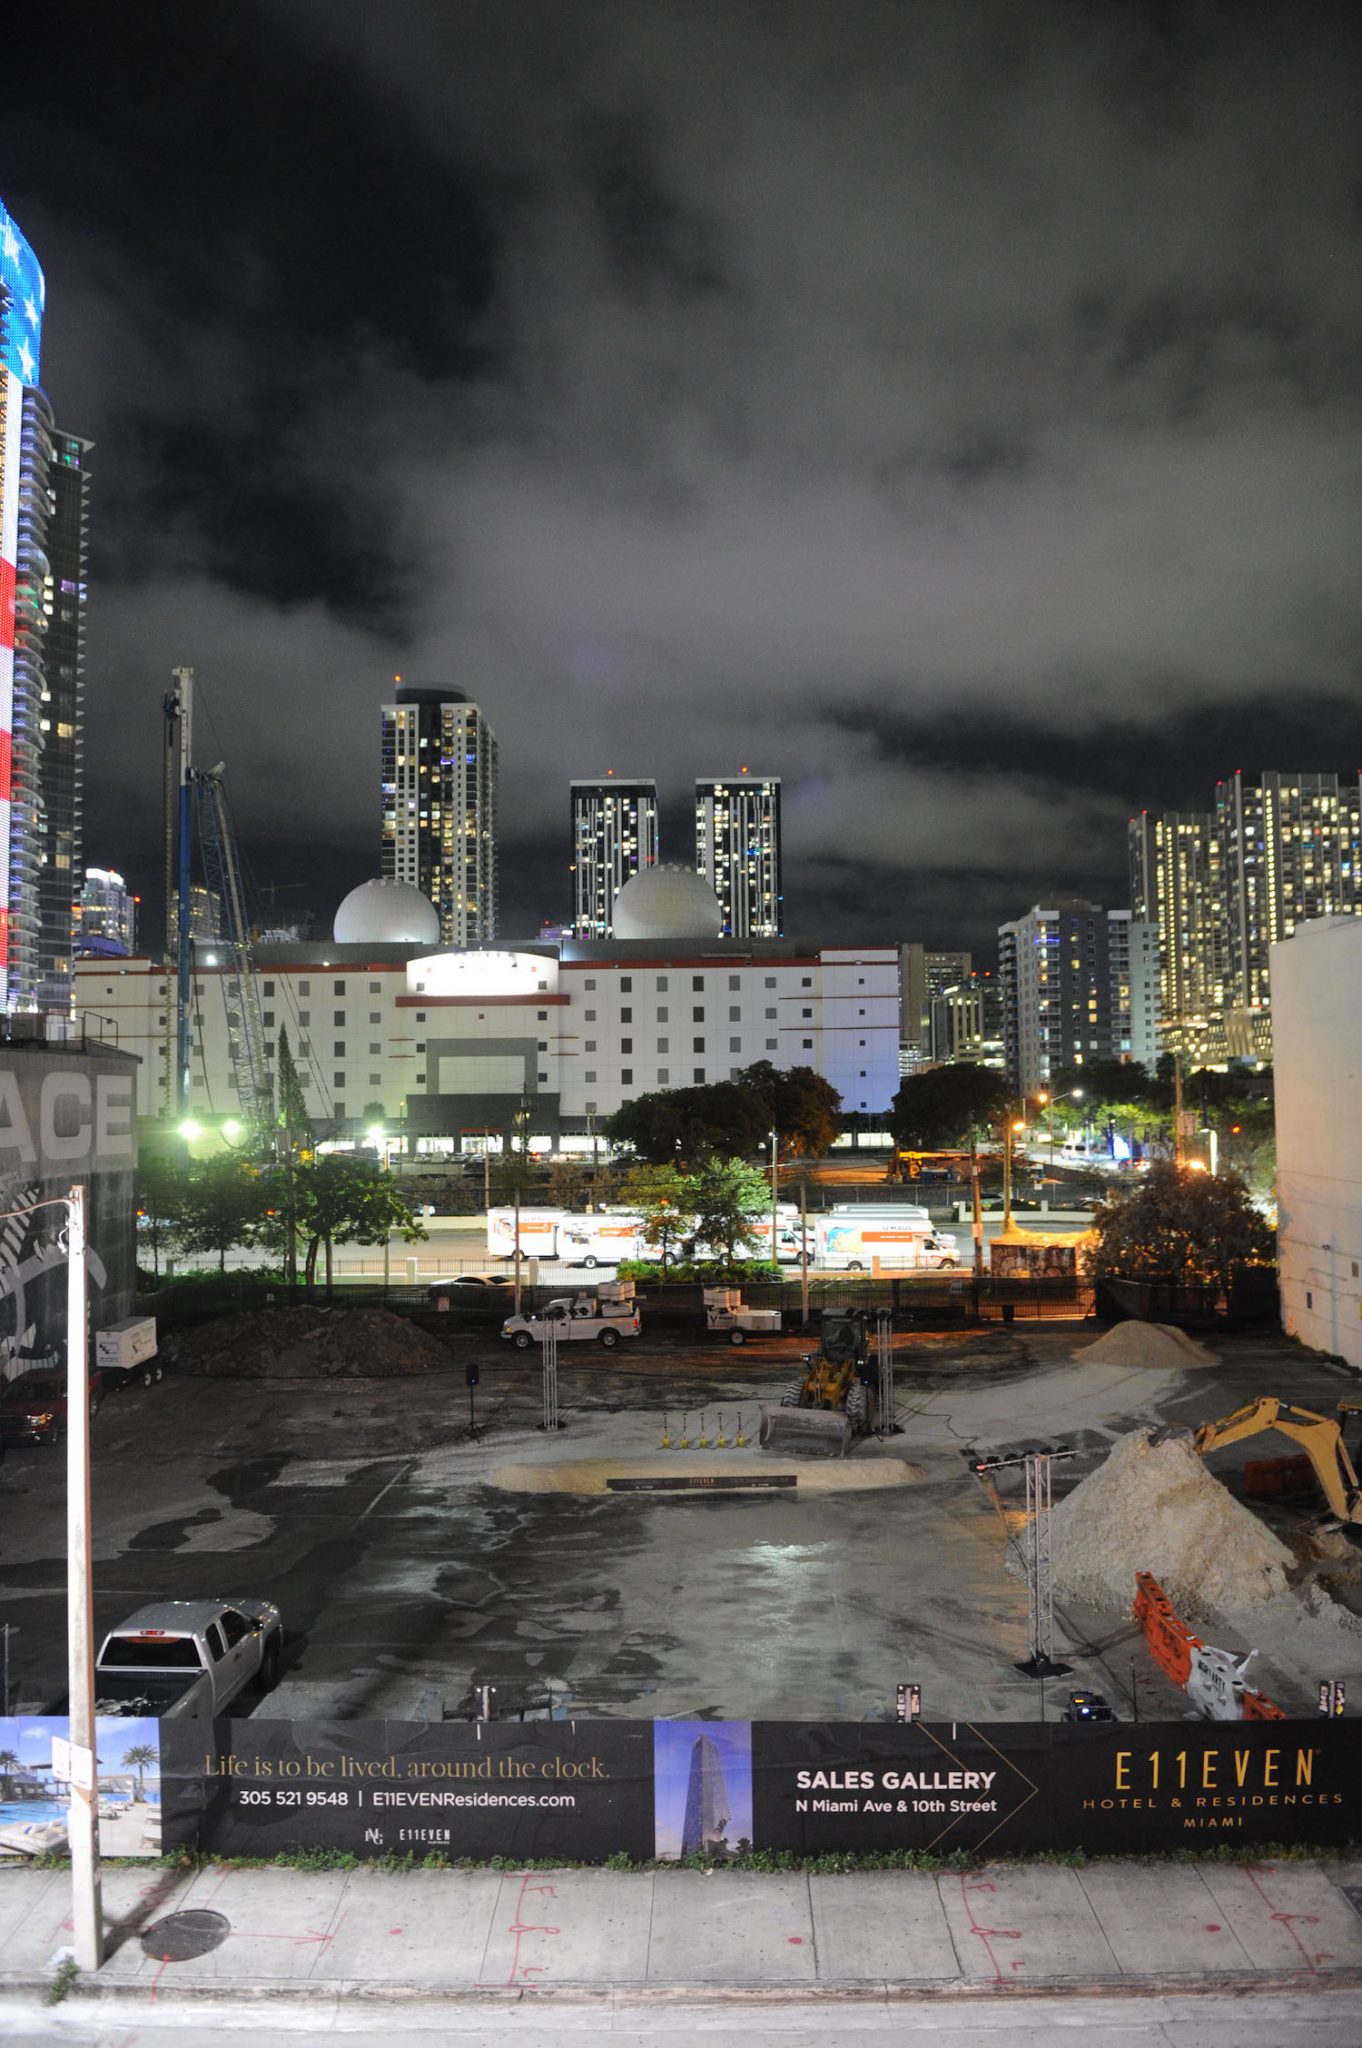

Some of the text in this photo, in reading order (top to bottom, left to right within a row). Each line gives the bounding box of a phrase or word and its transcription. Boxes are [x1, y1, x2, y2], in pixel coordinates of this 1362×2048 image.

[205, 1754, 248, 1777] Life
[255, 1756, 272, 1777] is
[278, 1759, 300, 1777] to
[306, 1755, 334, 1778] be
[407, 1756, 491, 1779] around
[499, 1756, 535, 1779] the
[541, 1756, 611, 1779] clock.
[1115, 1748, 1313, 1790] E11EVEN
[796, 1771, 996, 1790] SALES GALLERY
[239, 1791, 271, 1805] 305
[275, 1792, 301, 1805] 521
[306, 1792, 348, 1806] 9548
[372, 1792, 576, 1808] E11EVENResidences.com
[796, 1799, 997, 1813] N Miami Ave & 10th Street
[1083, 1794, 1343, 1809] HOTEL & RESIDENCES
[1183, 1817, 1243, 1828] MIAMI
[399, 1829, 450, 1841] E11EVEN
